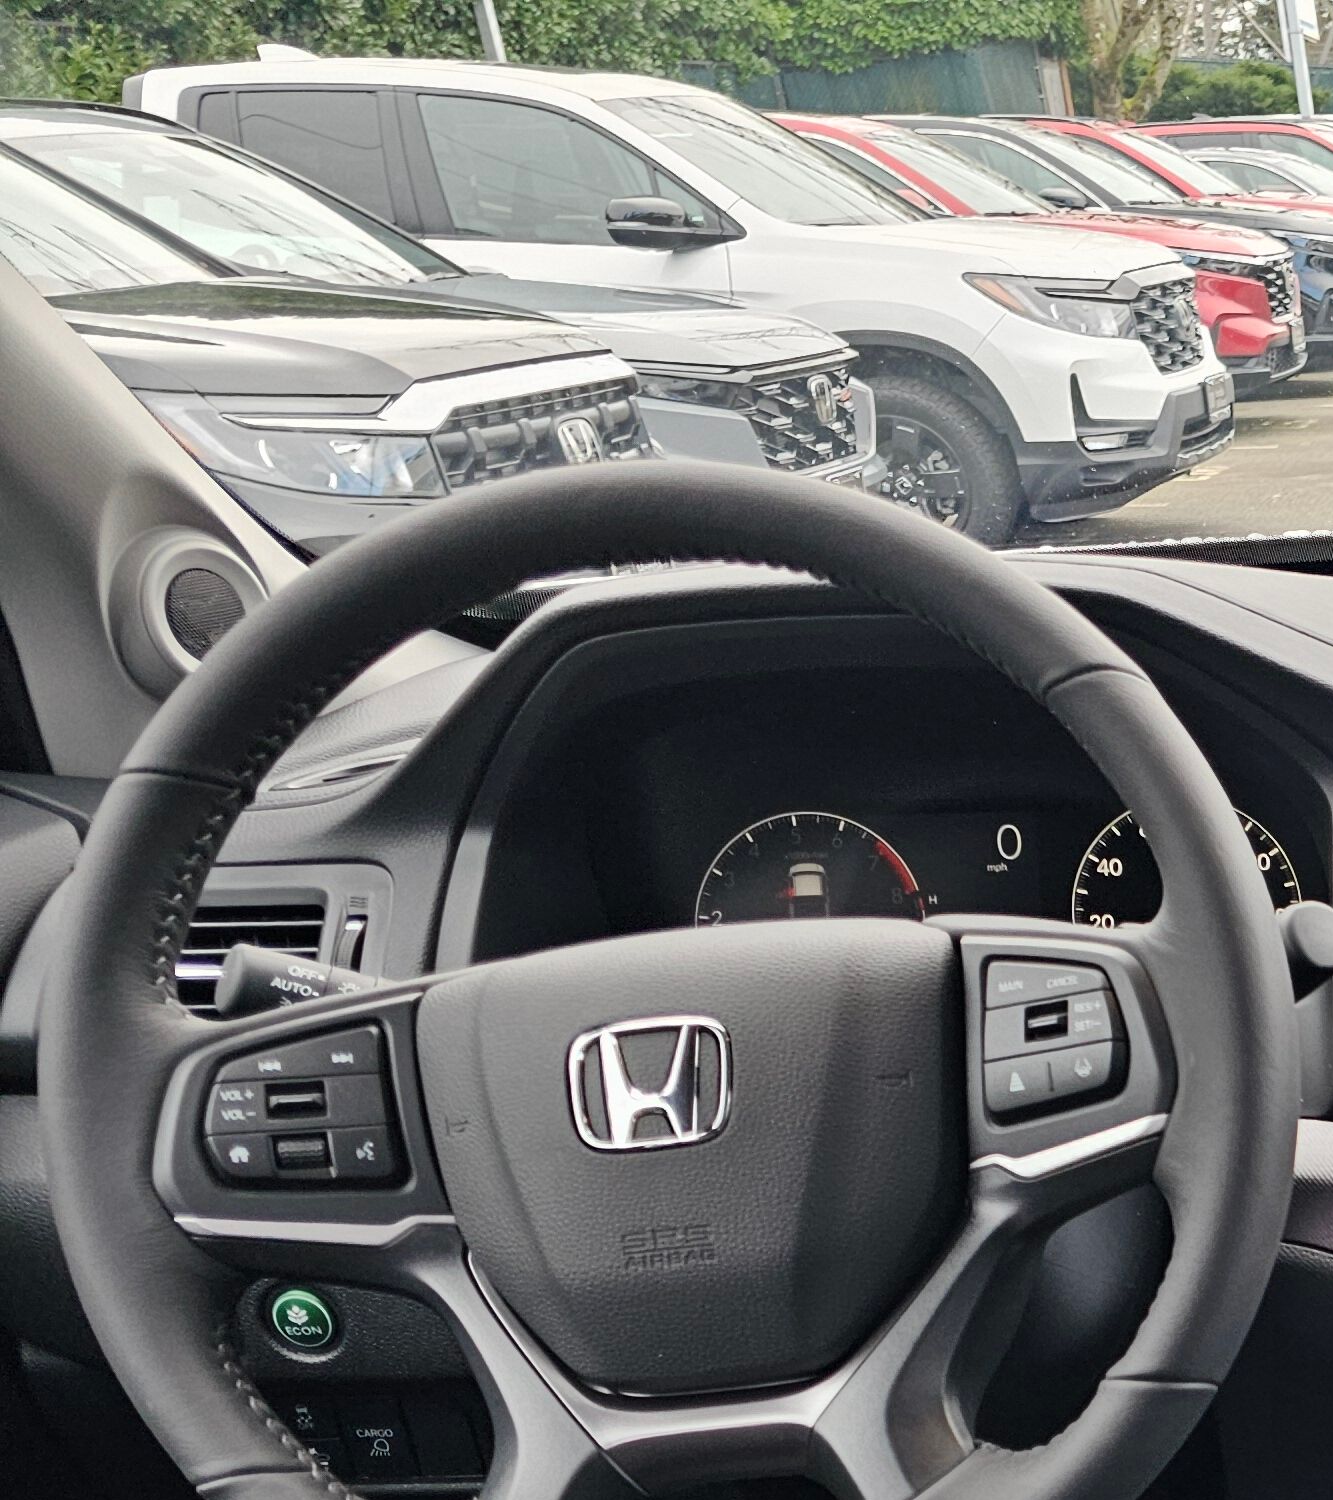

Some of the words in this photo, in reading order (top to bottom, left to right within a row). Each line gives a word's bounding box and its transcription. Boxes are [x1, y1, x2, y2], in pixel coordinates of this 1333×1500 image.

[996, 824, 1022, 860] 0
[987, 863, 1008, 872] mph
[1097, 858, 1123, 877] 40
[929, 896, 938, 904] H
[711, 910, 723, 926] 2
[1089, 914, 1115, 929] 20
[288, 965, 318, 980] OFF
[271, 977, 313, 997] AUTO
[284, 1325, 323, 1336] ECON
[355, 1428, 393, 1438] CARGO
